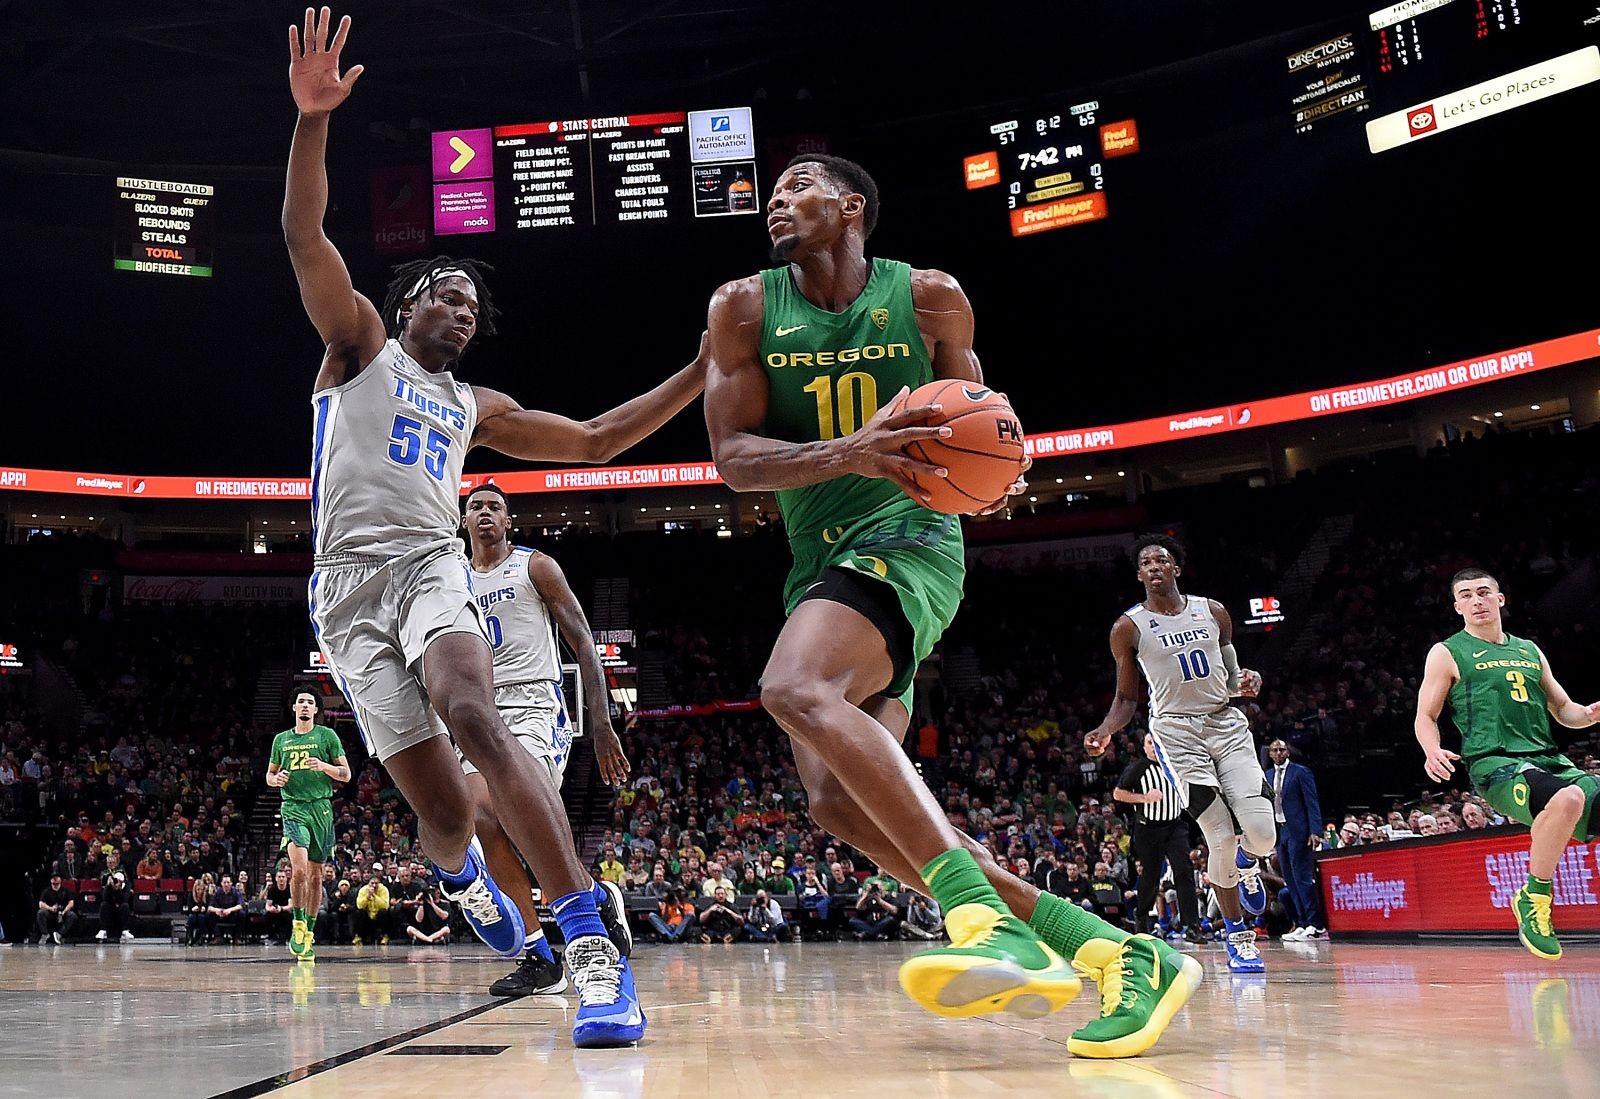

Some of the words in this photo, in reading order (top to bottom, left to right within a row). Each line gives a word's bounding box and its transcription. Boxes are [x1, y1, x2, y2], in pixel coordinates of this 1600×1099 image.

[1316, 51, 1355, 68] Mortgage
[1292, 88, 1327, 104] MORTGAGE
[1326, 74, 1361, 92] SPECIALIST
[1306, 80, 1324, 91] YOUR
[1443, 99, 1476, 118] Let's
[1480, 91, 1502, 106] Go
[1506, 73, 1556, 97] Places
[563, 119, 588, 131] STATS
[591, 117, 630, 129] CENTRAL
[612, 141, 636, 150] POINTS
[637, 140, 645, 148] IN
[646, 139, 666, 147] PAINT
[696, 135, 722, 143] PACIFIC
[698, 140, 747, 149] AUTOMATION
[516, 149, 534, 158] FIELD
[536, 148, 553, 156] GOAL
[554, 146, 569, 155] PCT.
[608, 154, 625, 162] FAST
[625, 152, 646, 161] BREAK
[647, 150, 670, 159] POINTS
[1018, 147, 1059, 170] 7:42
[514, 161, 531, 169] FREE
[532, 159, 555, 168] THROW
[557, 158, 572, 166] PCT.
[627, 163, 654, 172] ASSISTS
[513, 172, 529, 180] FREE
[530, 170, 555, 179] THROWS
[556, 169, 574, 177] MADE
[621, 174, 661, 185] TURNOVERS
[123, 179, 208, 194] HUSTLEBOARD
[531, 183, 551, 191] POINT
[552, 182, 567, 190] PCT.
[1095, 177, 1103, 189] 2
[120, 192, 156, 201] BLAZERS
[556, 192, 575, 201] MADE
[615, 187, 646, 197] CHARGES
[647, 186, 669, 195] TAKEN
[183, 198, 209, 206] GUEST
[621, 200, 641, 209] TOTAL
[642, 198, 664, 207] FOULS
[1008, 196, 1016, 209] 3
[135, 203, 168, 215] BLOCKED
[170, 206, 194, 217] SHOTS
[520, 208, 533, 216] OFF
[534, 205, 570, 215] REBOUNDS
[619, 212, 642, 221] BENCH
[643, 210, 668, 219] POINTS
[138, 217, 191, 231] REBOUNDS
[463, 216, 489, 227] moda
[532, 218, 559, 227] CHANCE
[142, 232, 187, 244] STEALS
[145, 247, 182, 260] TOTAL
[135, 262, 192, 275] BIOFREEZE
[767, 343, 910, 368] OREGON
[1310, 395, 1331, 412] ON
[1332, 371, 1447, 407] FREDMEYER.COM
[1449, 366, 1468, 385] OR
[1469, 359, 1499, 380] OUR
[1500, 351, 1535, 373] APP!
[393, 374, 467, 431] Tigers
[803, 371, 878, 441] 10
[1169, 414, 1224, 431] FredMeyer
[387, 413, 452, 482] 55
[1036, 437, 1054, 453] OR
[1055, 434, 1083, 451] OUR
[1084, 430, 1114, 447] APP!
[0, 472, 26, 486] APP!
[545, 474, 560, 488] ON
[563, 466, 660, 487] FREDMEYER.COM
[662, 465, 677, 482] OR
[680, 463, 704, 481] OUR
[196, 481, 211, 495] ON
[214, 482, 306, 496] FREDMEYER.COM
[475, 586, 516, 611] igers
[1158, 627, 1210, 649] Tigers
[1175, 649, 1211, 682] 10
[1475, 659, 1541, 671] OREGON
[1505, 670, 1529, 703] 3
[289, 751, 310, 770] 22
